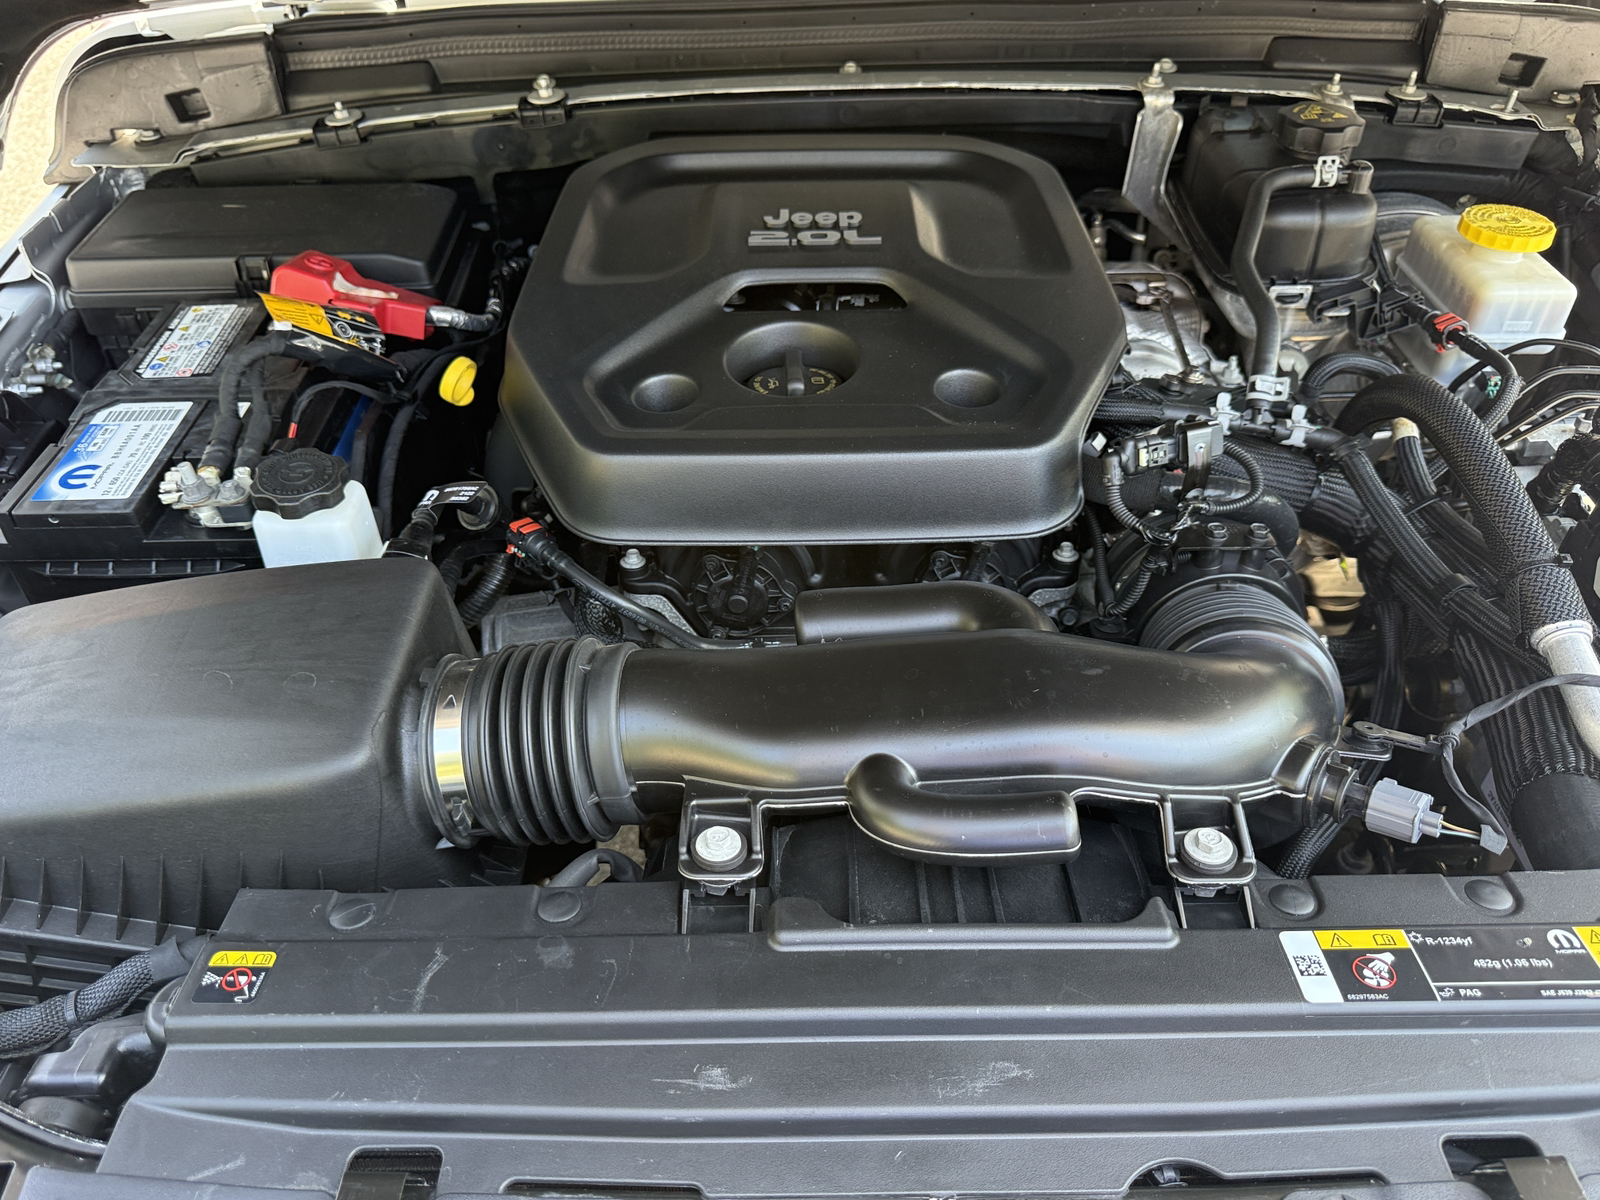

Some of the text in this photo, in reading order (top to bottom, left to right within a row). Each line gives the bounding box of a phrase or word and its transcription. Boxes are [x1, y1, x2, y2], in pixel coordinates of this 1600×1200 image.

[763, 208, 863, 230] Jeep
[748, 230, 882, 247] 2.0L
[1425, 936, 1473, 947] R-1234yf
[1473, 957, 1553, 970] 482g (1.06 lbs)
[1459, 989, 1482, 997] PAG
